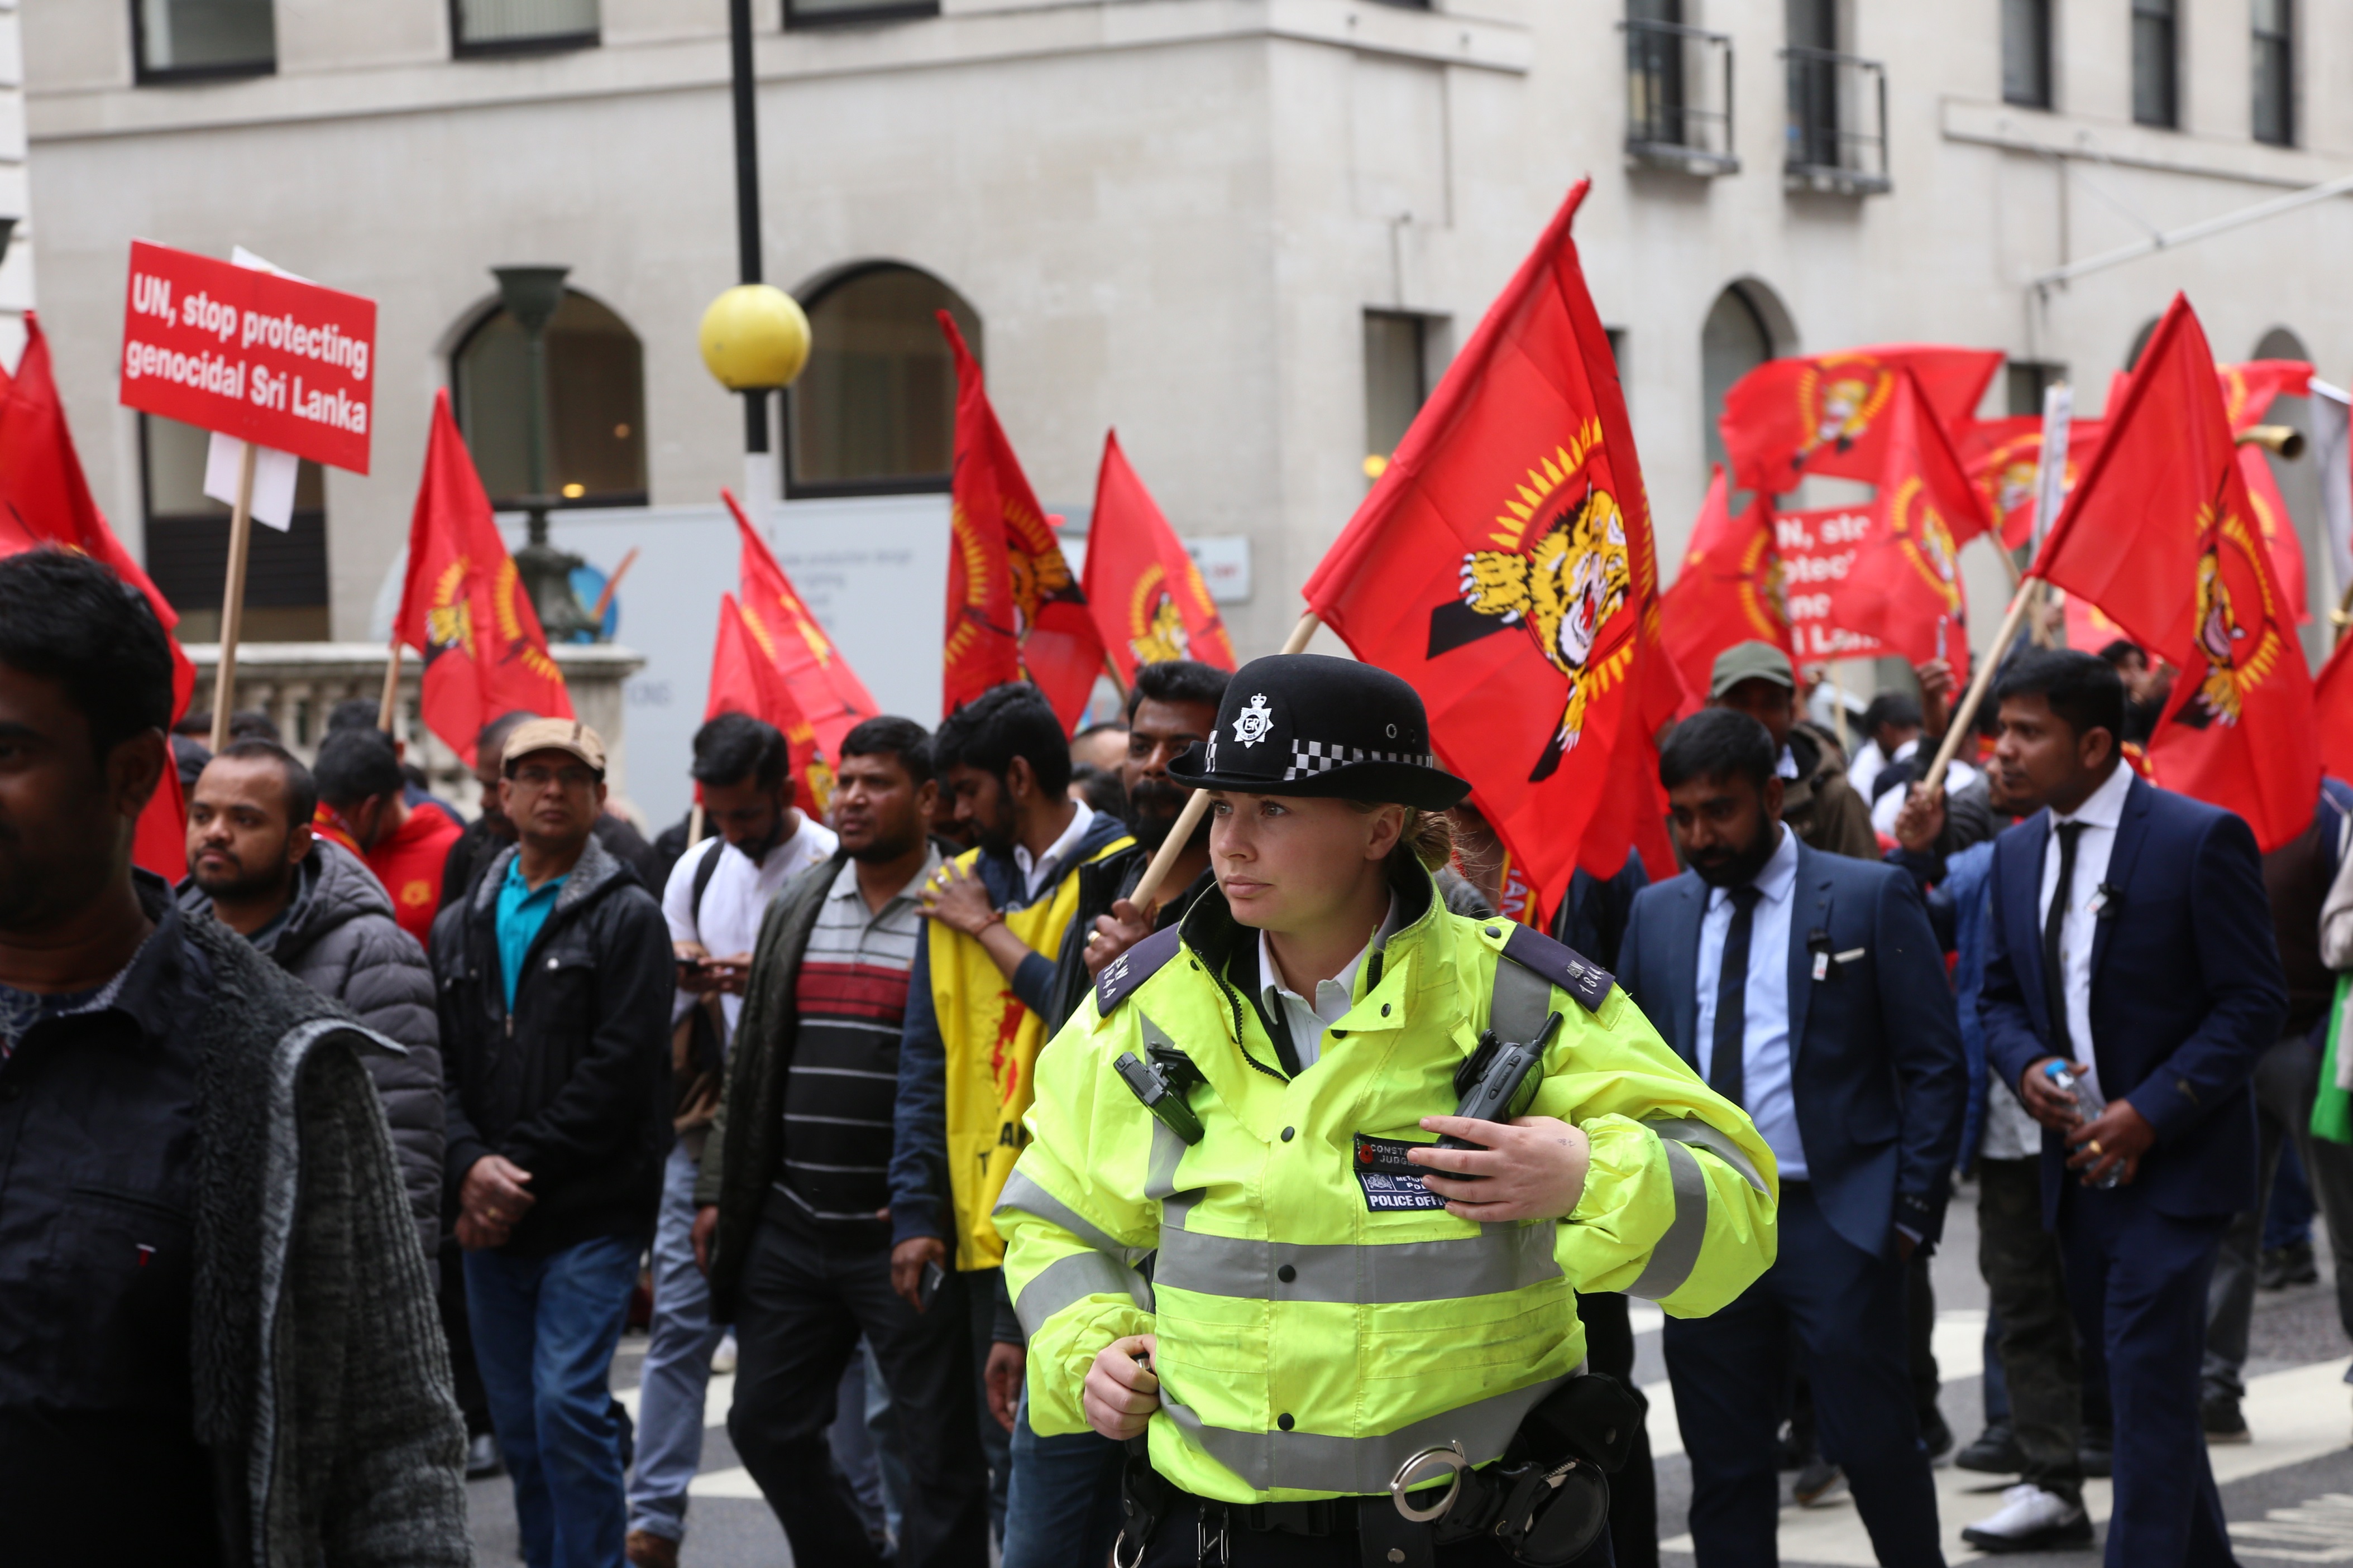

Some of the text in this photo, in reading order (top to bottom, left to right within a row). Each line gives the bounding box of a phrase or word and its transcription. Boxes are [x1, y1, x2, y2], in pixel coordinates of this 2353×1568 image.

[133, 272, 369, 381] UN, stop protecting
[125, 339, 367, 434] genocidal Sri Lanka
[1579, 966, 1605, 995] 1844
[1370, 1195, 1453, 1207] POLICE OFFIC
